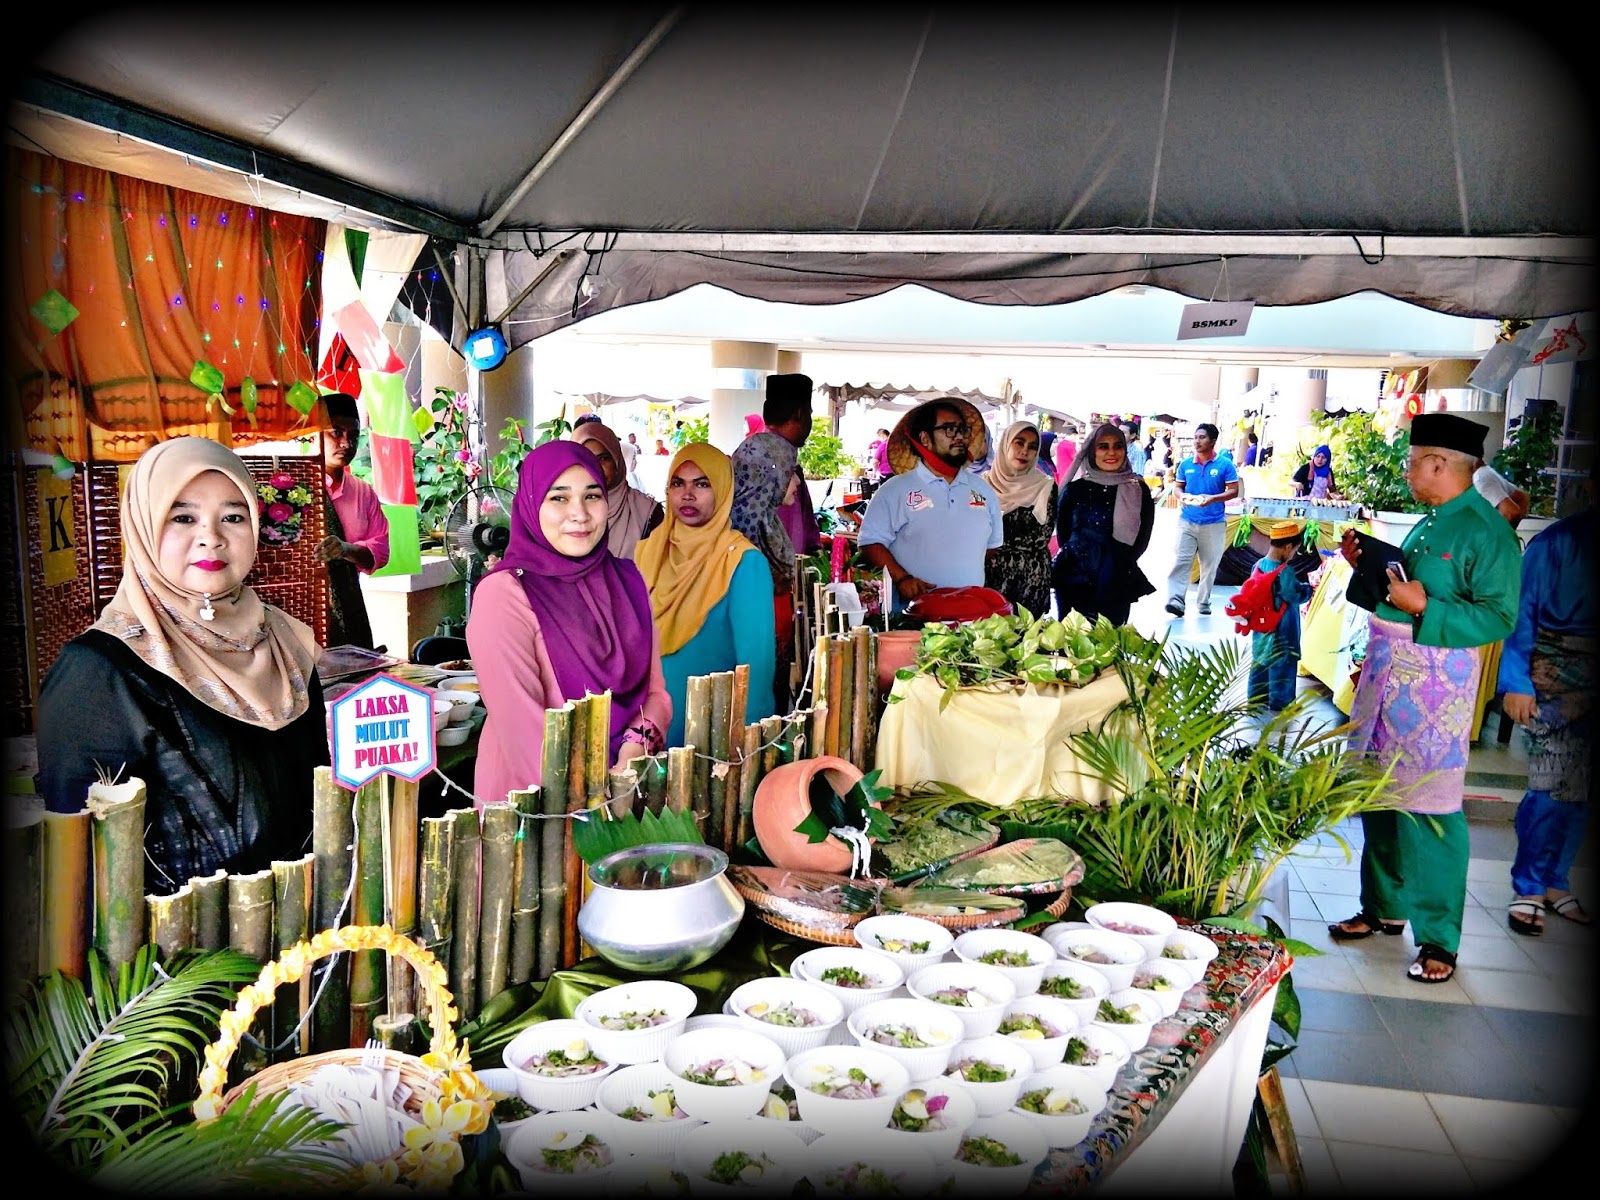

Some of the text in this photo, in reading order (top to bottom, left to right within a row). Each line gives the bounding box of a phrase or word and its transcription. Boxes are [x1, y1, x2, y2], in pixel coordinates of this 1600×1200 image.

[1191, 319, 1237, 329] BSMKP
[45, 495, 73, 553] K
[355, 694, 409, 718] LAKSA
[355, 718, 410, 743] MULUT
[355, 742, 419, 769] PUAKA!
